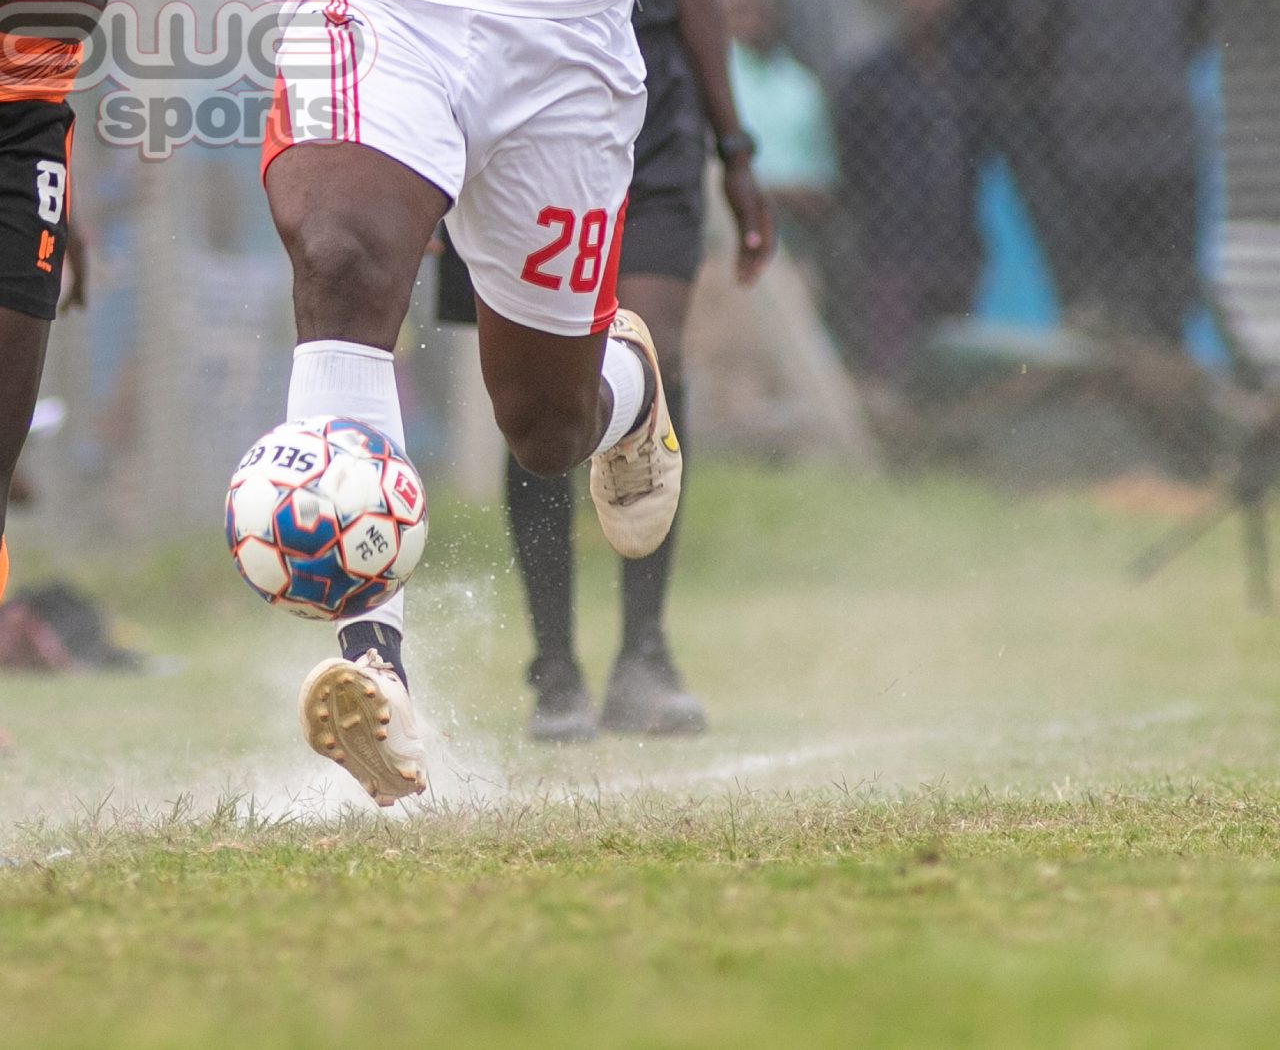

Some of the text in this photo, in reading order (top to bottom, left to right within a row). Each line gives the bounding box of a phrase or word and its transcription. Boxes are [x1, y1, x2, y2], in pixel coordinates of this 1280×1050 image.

[36, 159, 66, 225] 8
[520, 205, 608, 293] 28
[239, 445, 317, 473] SELEC
[355, 540, 374, 562] FC
[365, 524, 389, 554] NEC
